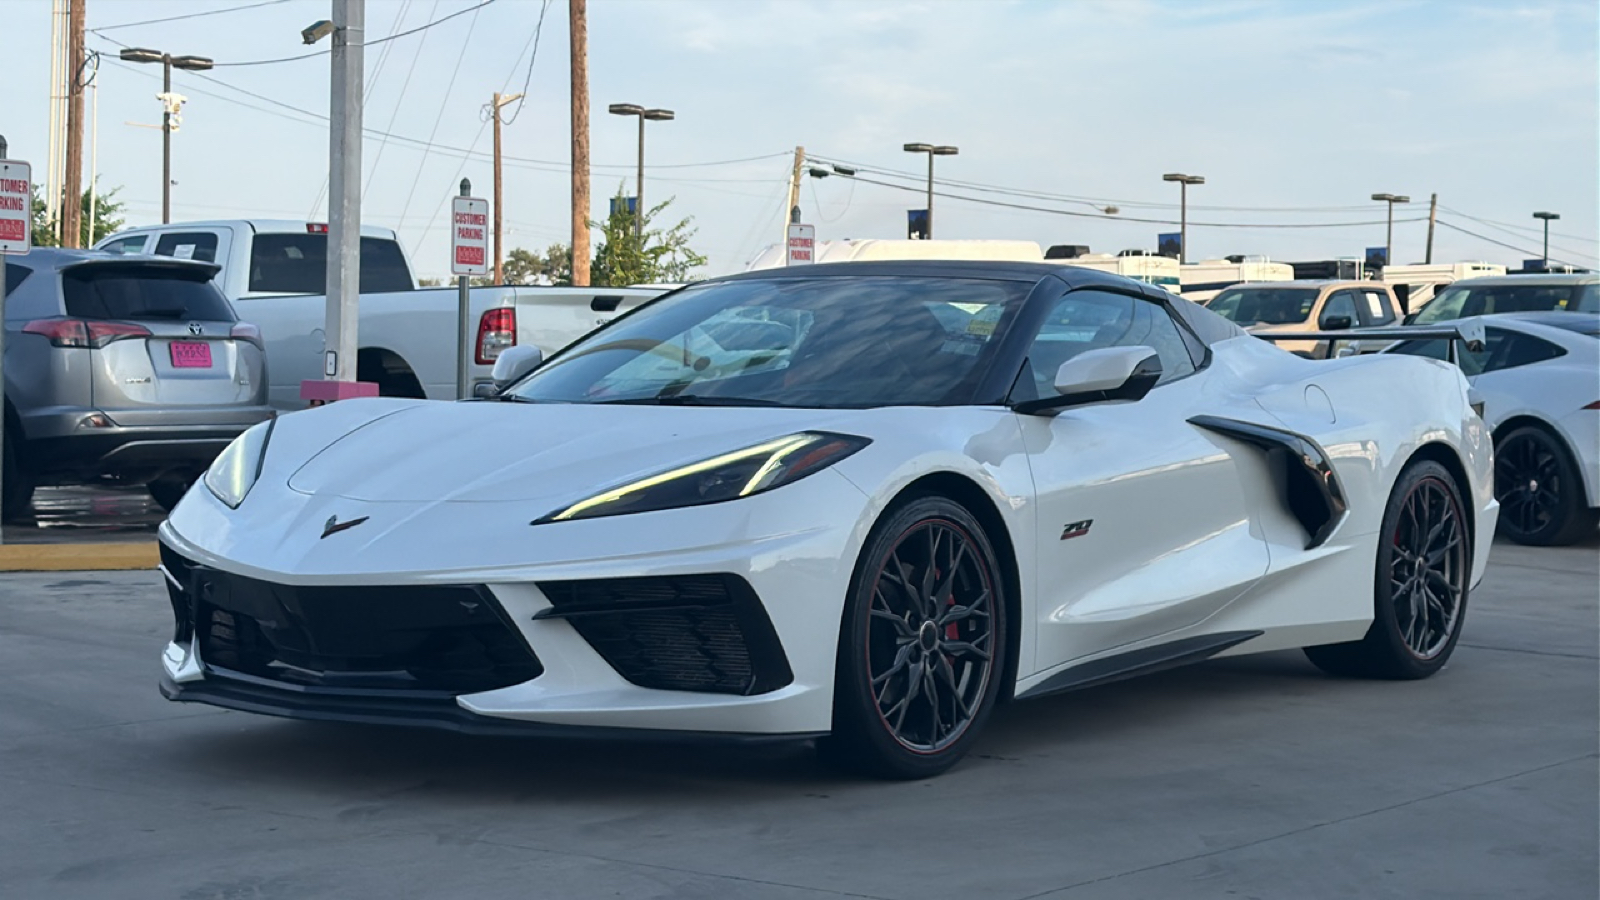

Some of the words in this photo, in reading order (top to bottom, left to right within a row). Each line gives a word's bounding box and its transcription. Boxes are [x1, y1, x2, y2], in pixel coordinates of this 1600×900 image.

[455, 211, 486, 225] CUSTOMER
[458, 226, 483, 240] PARKING
[791, 249, 811, 260] PARKING
